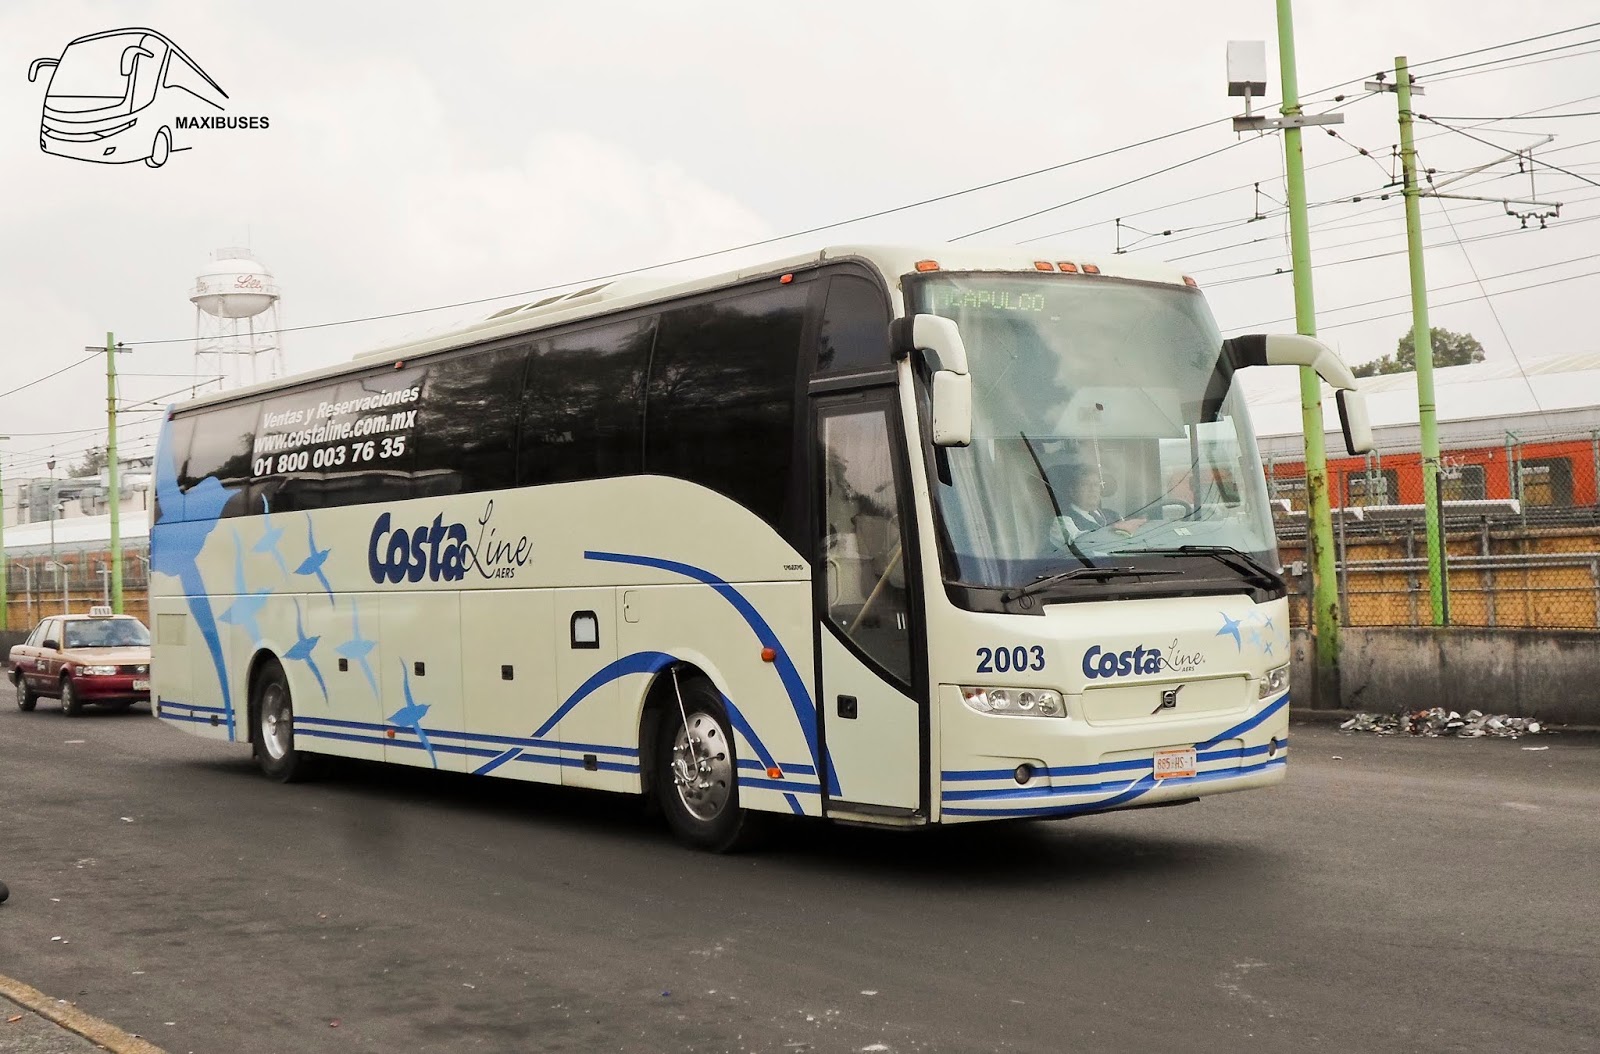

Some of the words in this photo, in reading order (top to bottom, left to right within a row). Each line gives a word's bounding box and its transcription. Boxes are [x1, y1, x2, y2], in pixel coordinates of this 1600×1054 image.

[263, 408, 303, 429] Ventas
[304, 407, 315, 426] y
[316, 386, 420, 419] Reservaciones
[253, 409, 418, 453] www.costaline.com.mx
[253, 457, 273, 477] 01
[277, 451, 309, 473] 800
[313, 445, 346, 468] 003
[351, 440, 375, 463] 76
[379, 436, 406, 459] 35
[368, 511, 468, 584] Costa
[459, 499, 533, 579] Line
[495, 567, 515, 579] AERS
[976, 645, 1045, 673] 2003
[1082, 644, 1162, 679] Costa
[1158, 638, 1204, 672] Line
